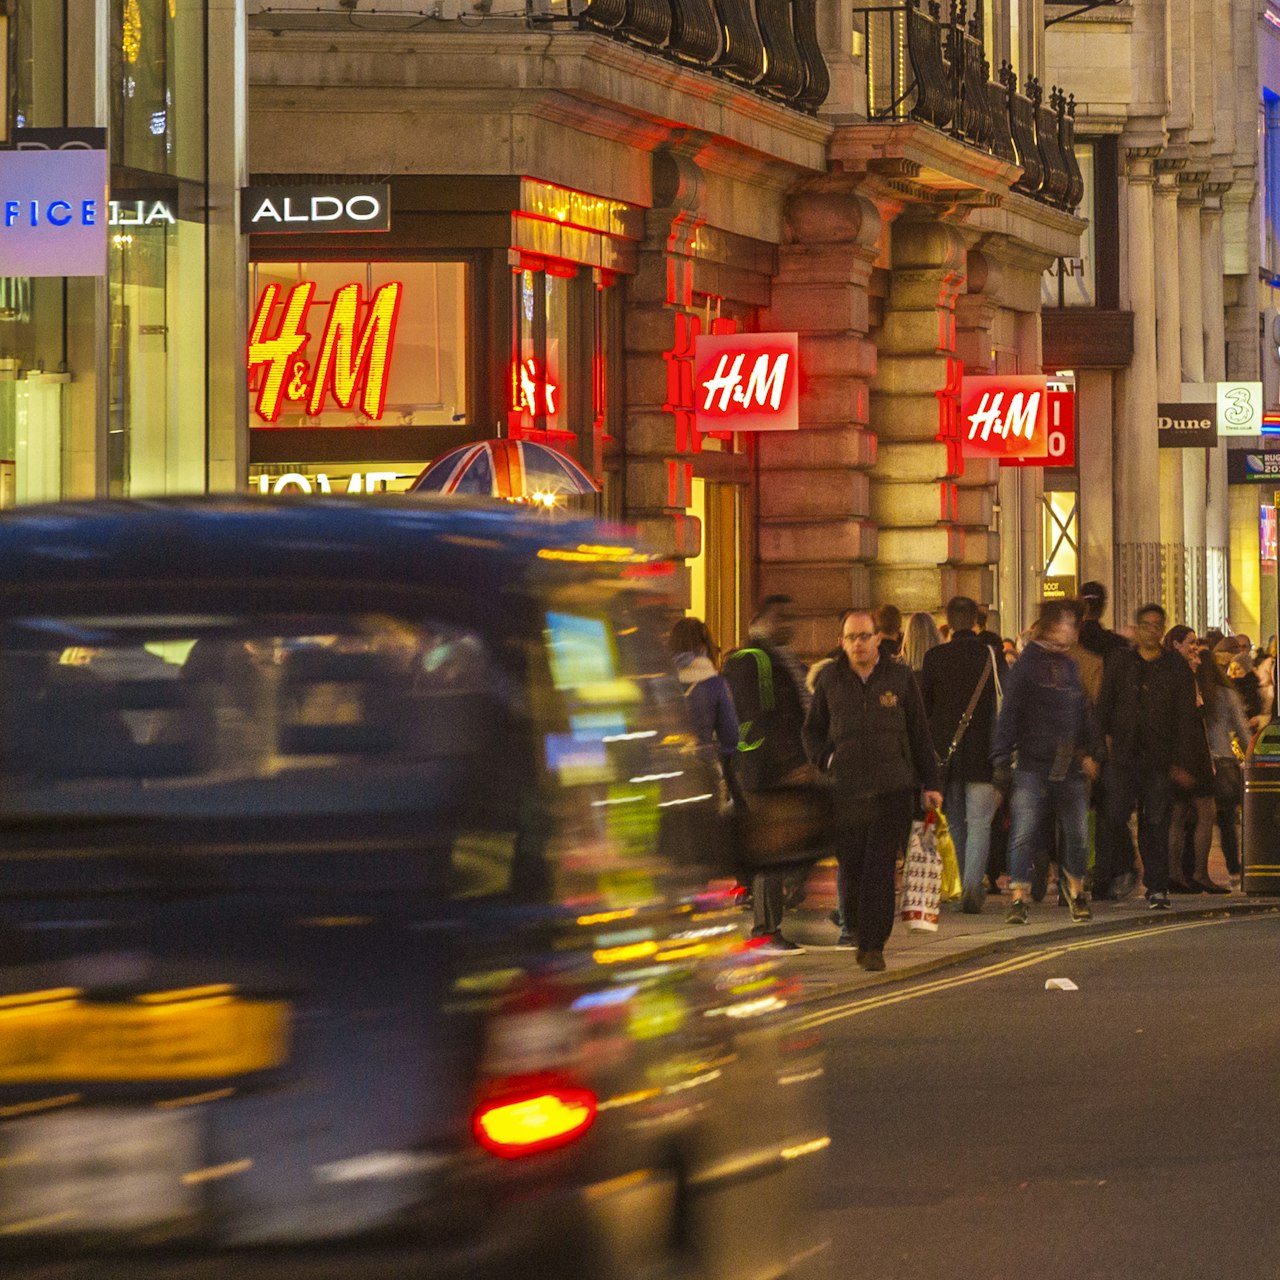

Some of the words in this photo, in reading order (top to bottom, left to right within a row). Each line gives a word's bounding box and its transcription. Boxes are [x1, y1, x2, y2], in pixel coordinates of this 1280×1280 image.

[251, 194, 381, 223] ALDO
[247, 281, 404, 422] H&M
[703, 353, 789, 413] H&M
[967, 391, 1041, 442] H&M
[1158, 416, 1212, 430] Dune
